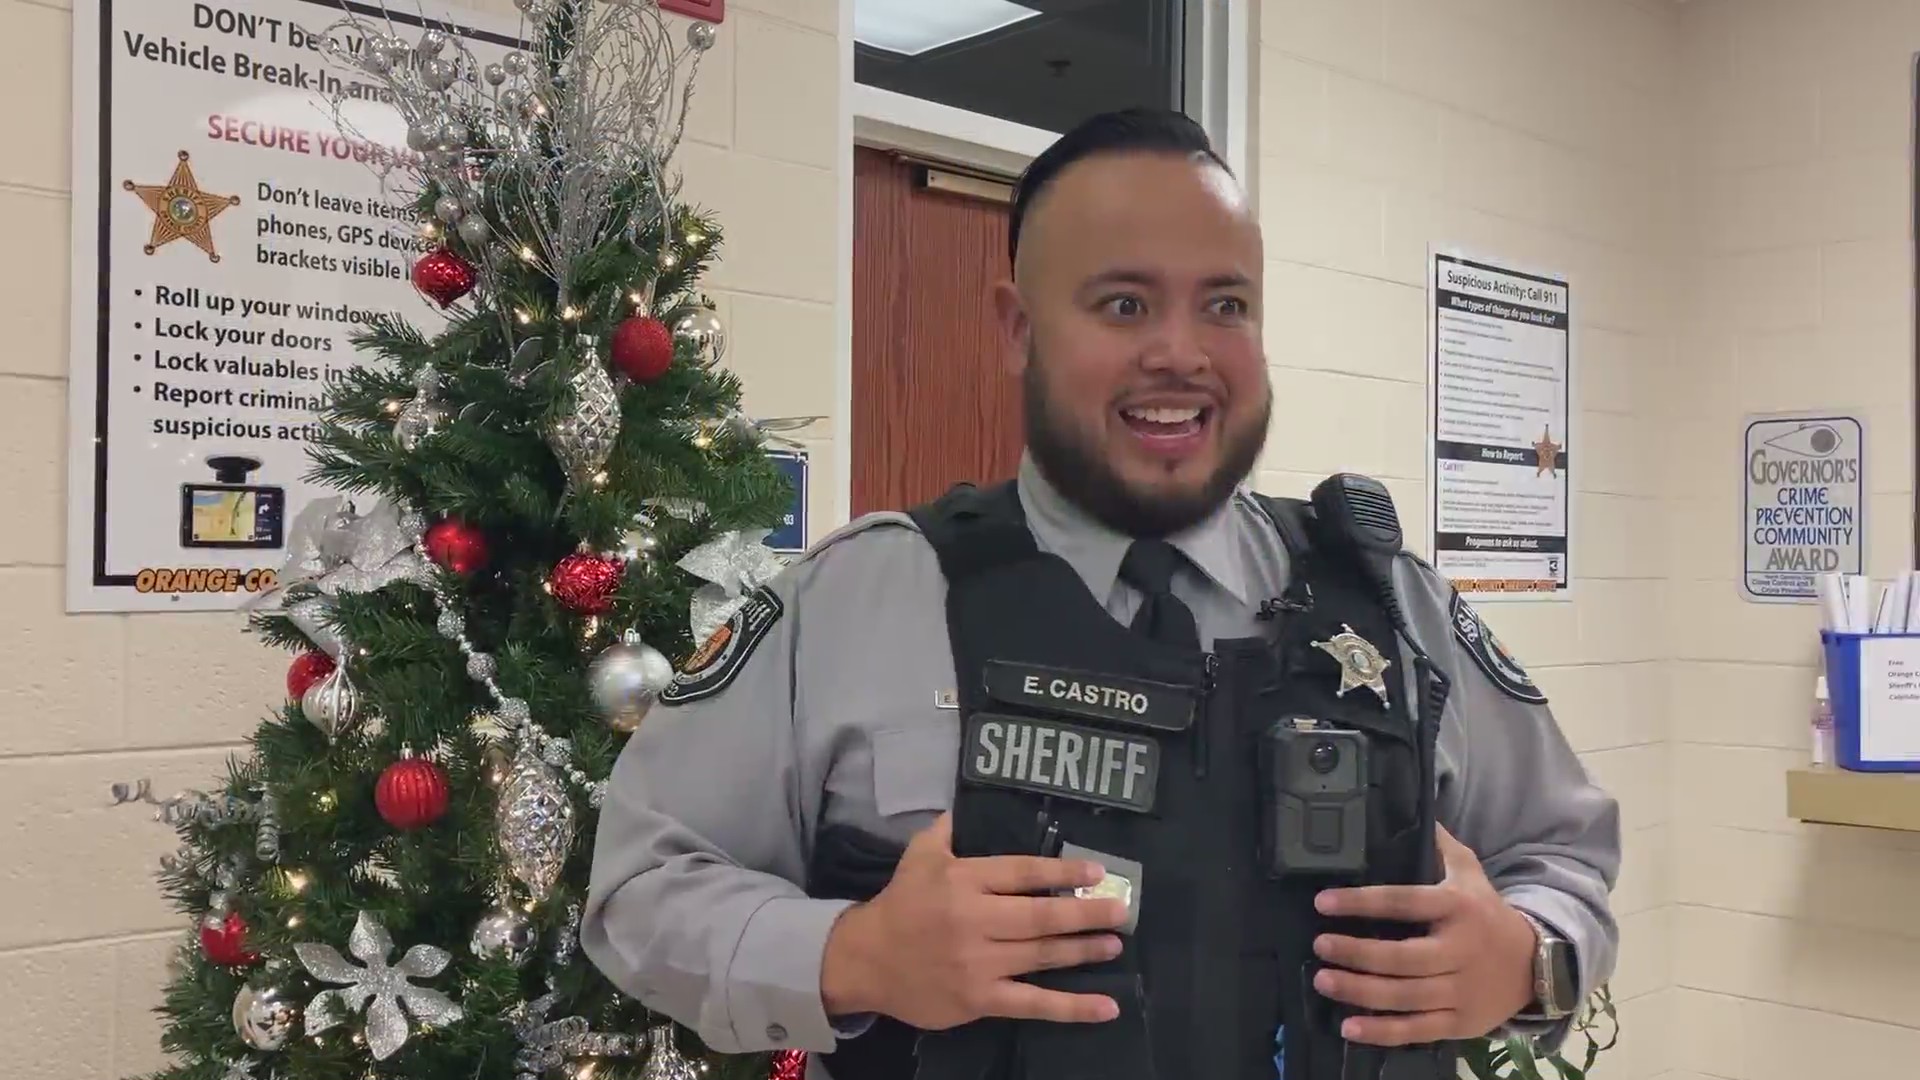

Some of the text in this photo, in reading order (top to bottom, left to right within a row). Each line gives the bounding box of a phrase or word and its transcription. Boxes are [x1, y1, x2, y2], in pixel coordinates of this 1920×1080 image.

[194, 3, 282, 43] DON'T
[289, 22, 320, 51] be
[123, 30, 226, 74] Vehicle
[234, 53, 342, 95] Break-In
[208, 114, 311, 154] SECURE
[258, 182, 309, 208] Don't
[315, 190, 363, 215] leave
[257, 214, 438, 254] phones, GPS device
[257, 244, 337, 272] brackets
[342, 256, 401, 280] visible
[156, 285, 388, 325] Roll up your windows
[1447, 270, 1557, 305] Suspicious Activity: Call 911
[155, 317, 332, 352] Lock your doors
[155, 350, 209, 373] Lock
[214, 356, 319, 381] valuables
[154, 382, 233, 408] Report
[153, 416, 272, 440] suspicious
[1750, 449, 1857, 485] GOVERNOR'S
[1777, 487, 1829, 506] CRIME
[1756, 507, 1853, 526] PREVENTION
[1754, 527, 1853, 546] COMMUNITY
[1765, 548, 1840, 571] AWARD
[136, 568, 279, 593] ORANGE CO
[1023, 676, 1148, 715] E. CASTRO
[976, 722, 1148, 800] SHERIFF
